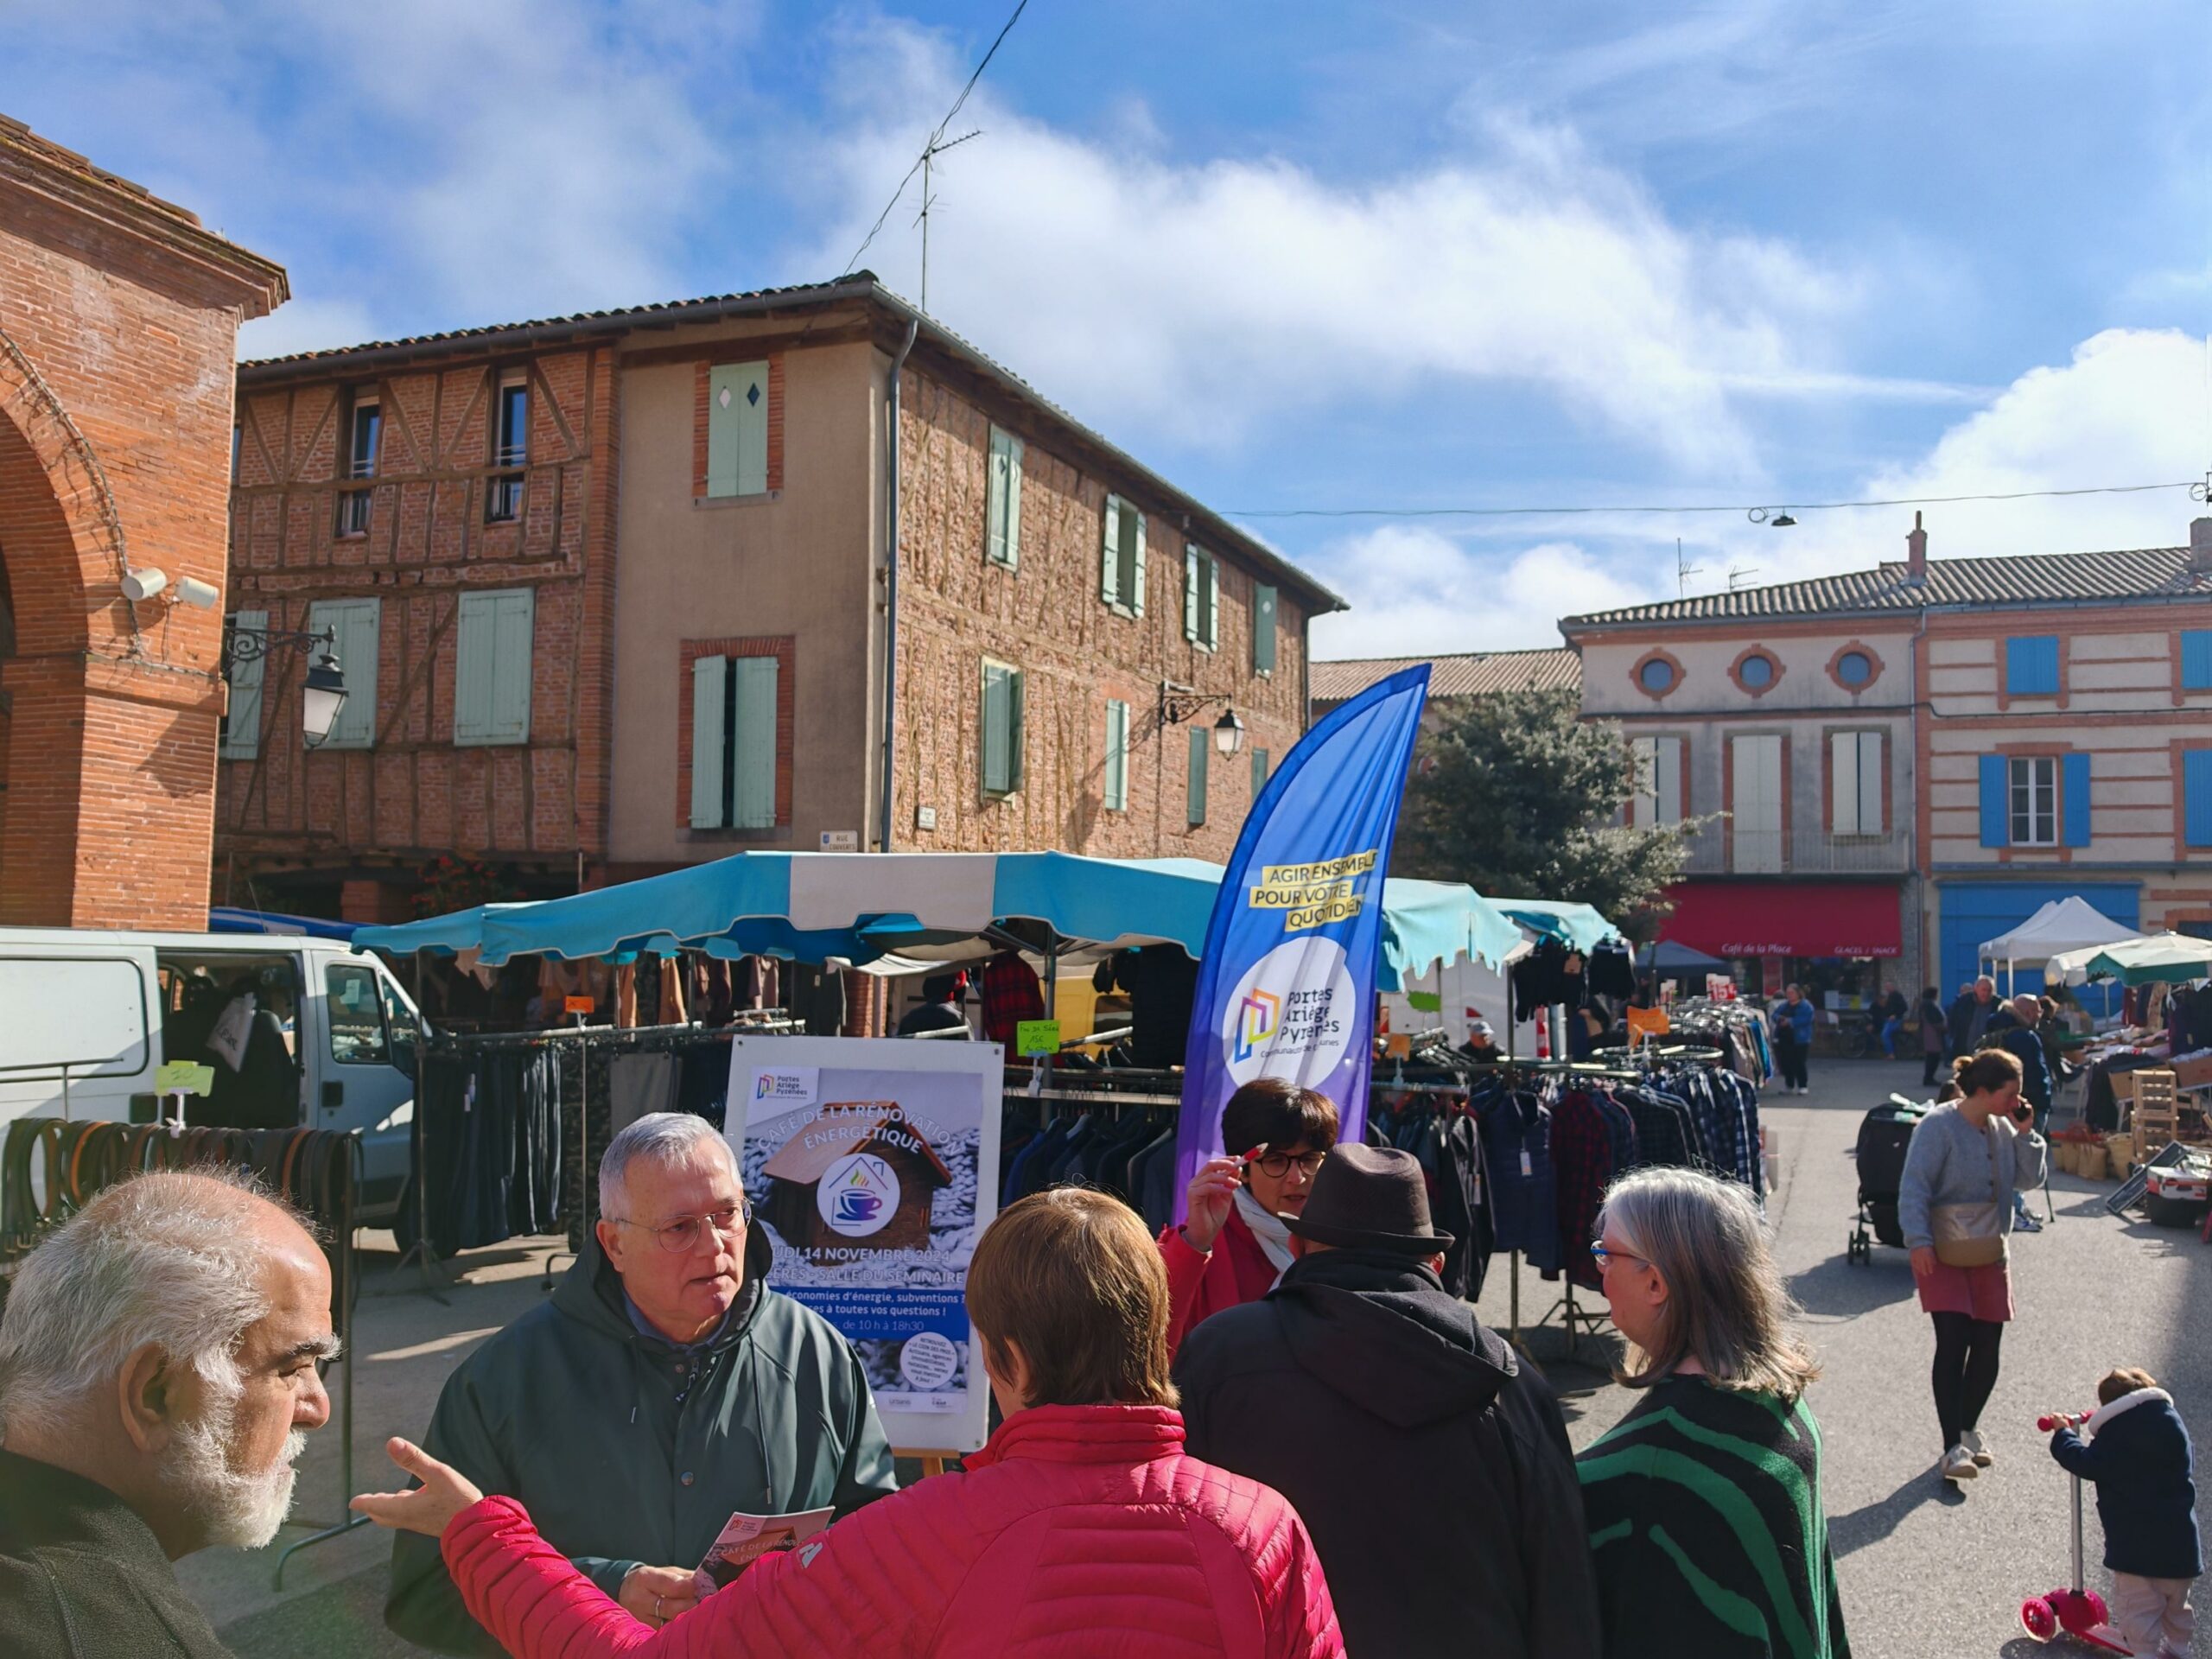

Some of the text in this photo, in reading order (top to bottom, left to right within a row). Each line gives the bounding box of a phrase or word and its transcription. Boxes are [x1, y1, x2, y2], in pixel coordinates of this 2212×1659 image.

[1269, 868, 1310, 883] AGIR
[1255, 884, 1348, 905] POUR VOTRE
[1743, 943, 1755, 954] de
[1757, 943, 1766, 954] la
[1768, 943, 1792, 954] Place
[1287, 988, 1333, 1007] Portes
[757, 1102, 962, 1156] CAFÉ DE LA RÉNOVATION
[772, 1246, 950, 1262] UDI 14 NOVEMBRE 2024
[819, 1268, 860, 1281] SALLE
[863, 1270, 884, 1281] DU
[897, 1293, 959, 1304] subventions
[826, 1303, 834, 1313] à
[836, 1305, 868, 1314] toutes
[890, 1306, 941, 1317] questions
[842, 1319, 855, 1330] de
[858, 1320, 872, 1330] 10
[882, 1319, 889, 1330] à
[893, 1320, 925, 1331] 18h30
[720, 1542, 746, 1556] CAFÉ
